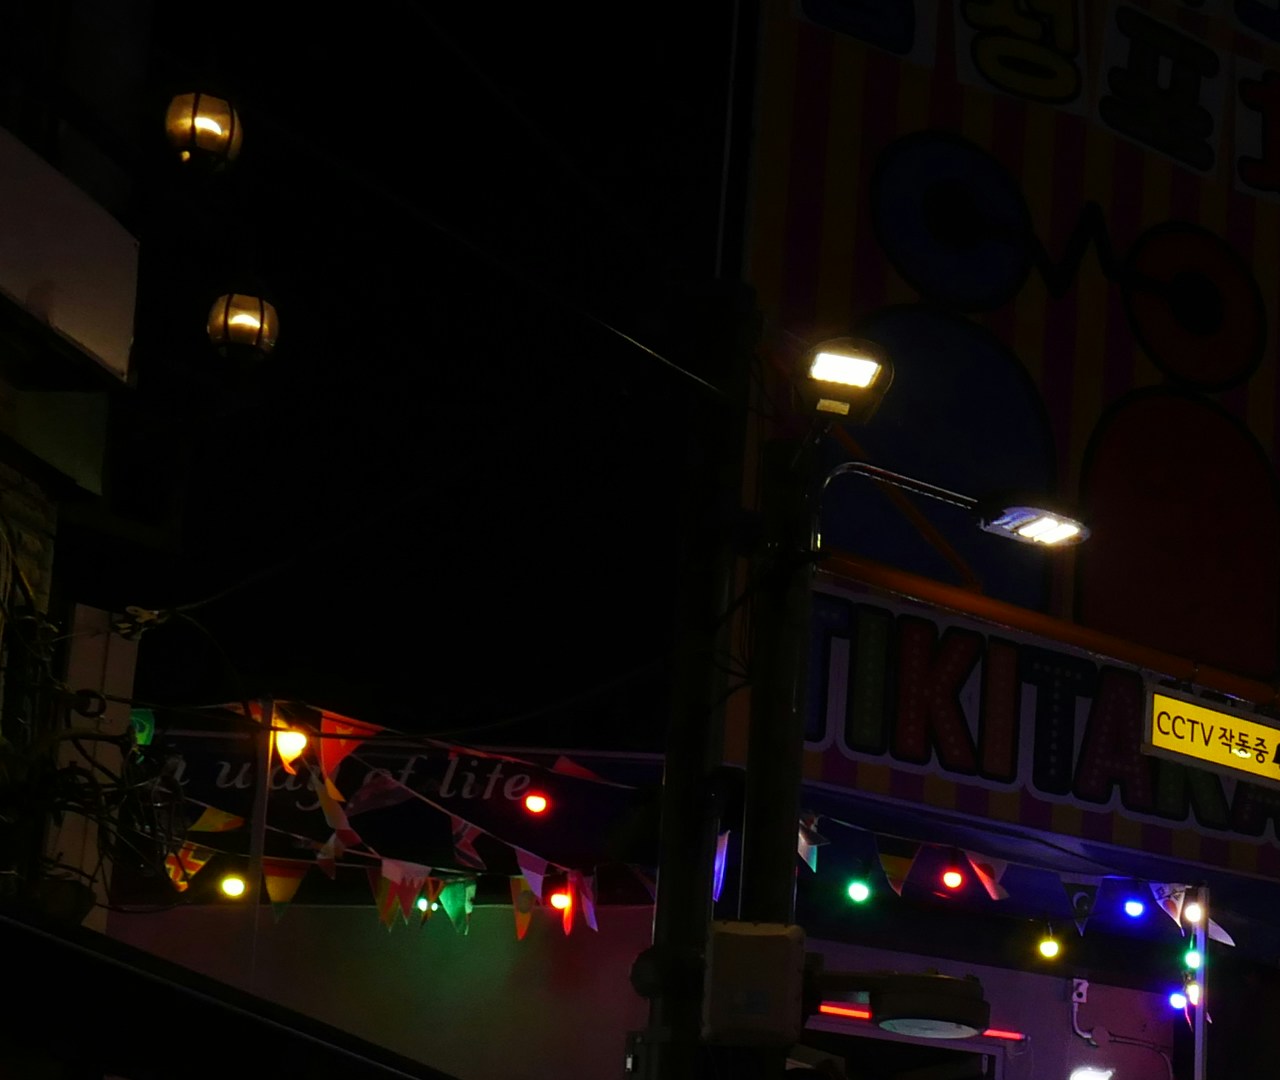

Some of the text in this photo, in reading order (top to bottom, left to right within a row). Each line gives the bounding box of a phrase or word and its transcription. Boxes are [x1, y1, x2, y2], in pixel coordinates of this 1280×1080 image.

[1156, 710, 1269, 764] CCTV 작동중
[438, 752, 532, 800] life
